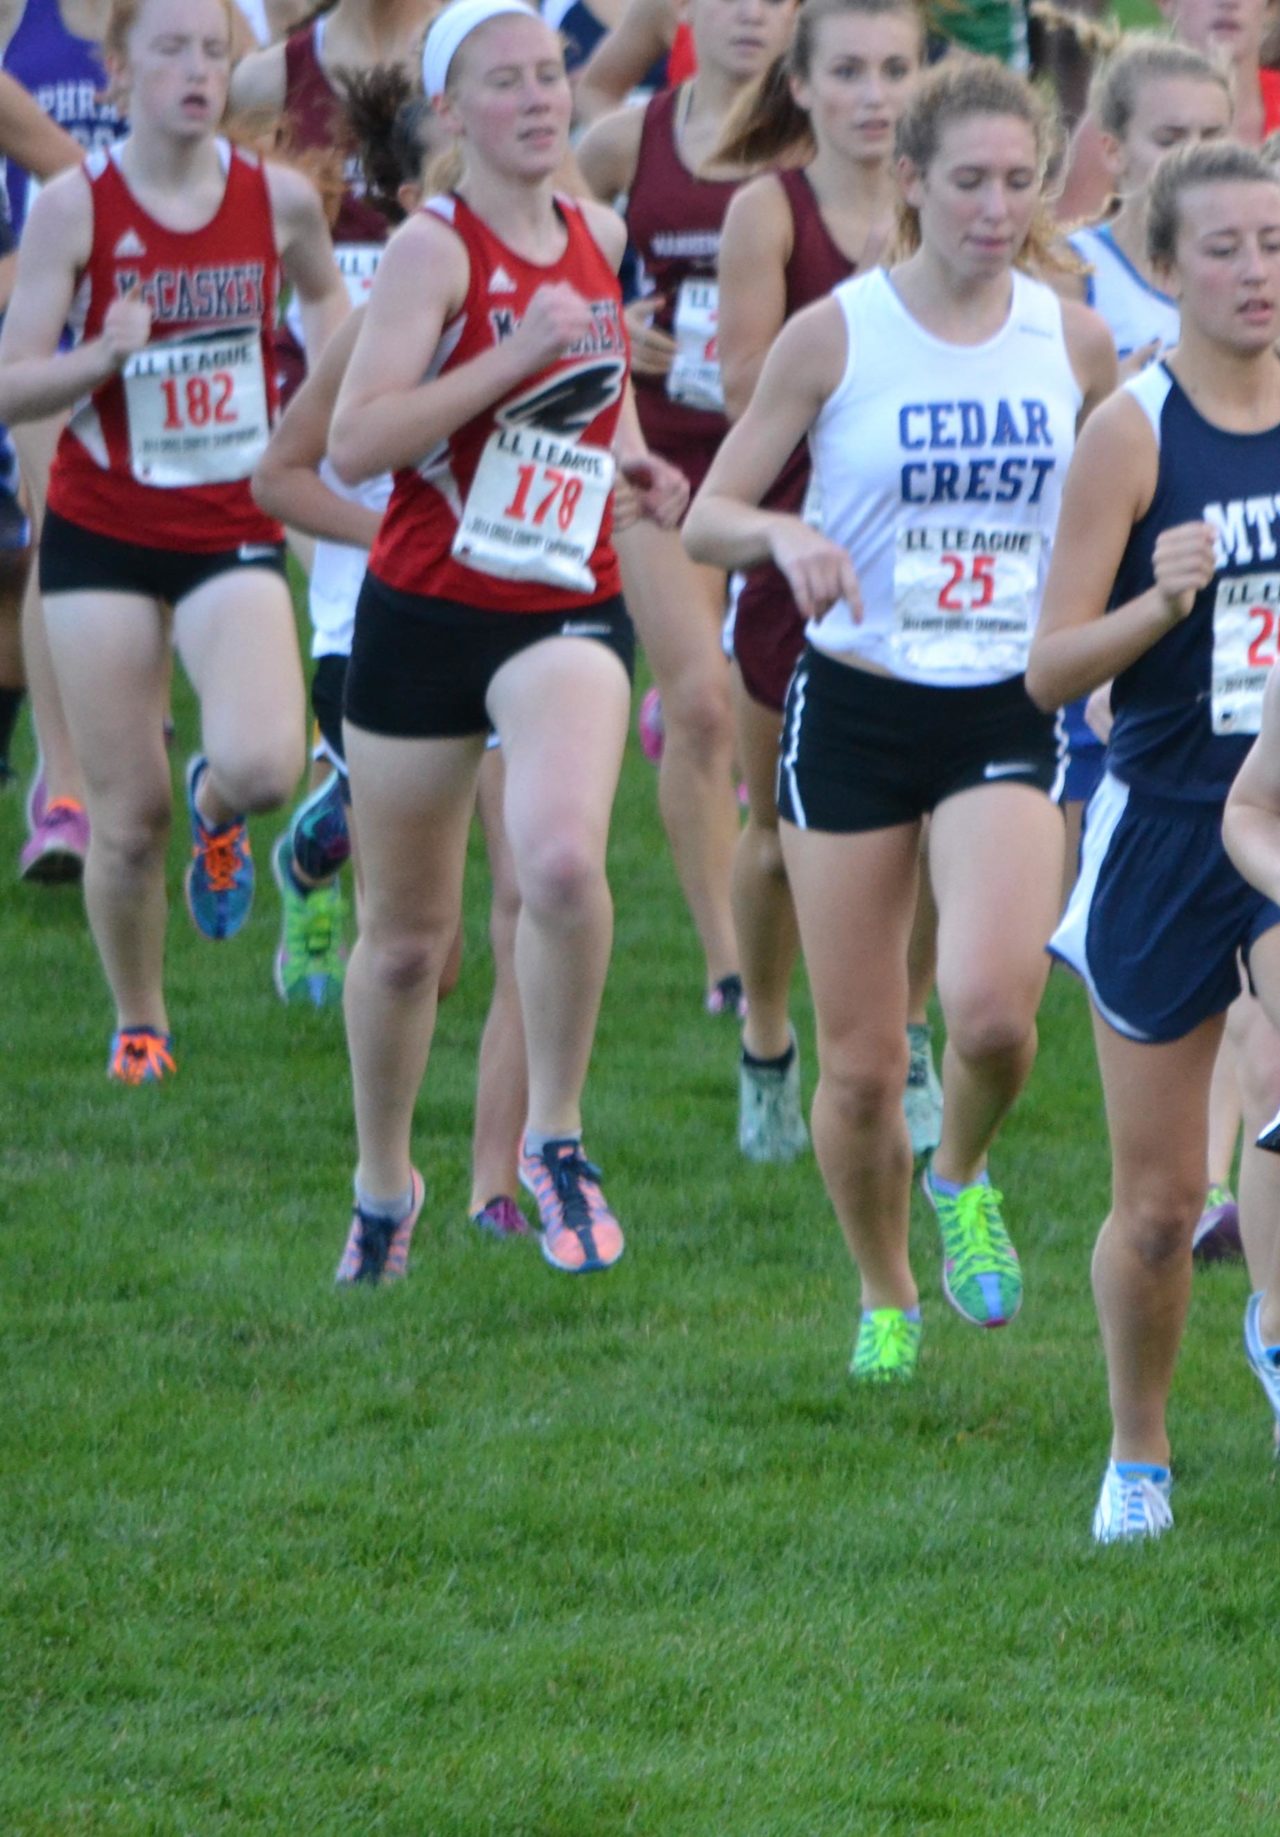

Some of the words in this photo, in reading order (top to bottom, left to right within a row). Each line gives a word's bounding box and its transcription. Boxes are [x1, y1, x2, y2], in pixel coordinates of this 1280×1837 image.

[167, 346, 249, 376] LEAGUE
[160, 370, 239, 432] 182
[899, 397, 1054, 451] CEDAR
[504, 463, 584, 534] 178
[901, 457, 1056, 504] CREST
[907, 528, 935, 551] LL
[941, 527, 1032, 552] LEAGUE
[937, 553, 996, 611] 25
[1227, 584, 1254, 606] LL
